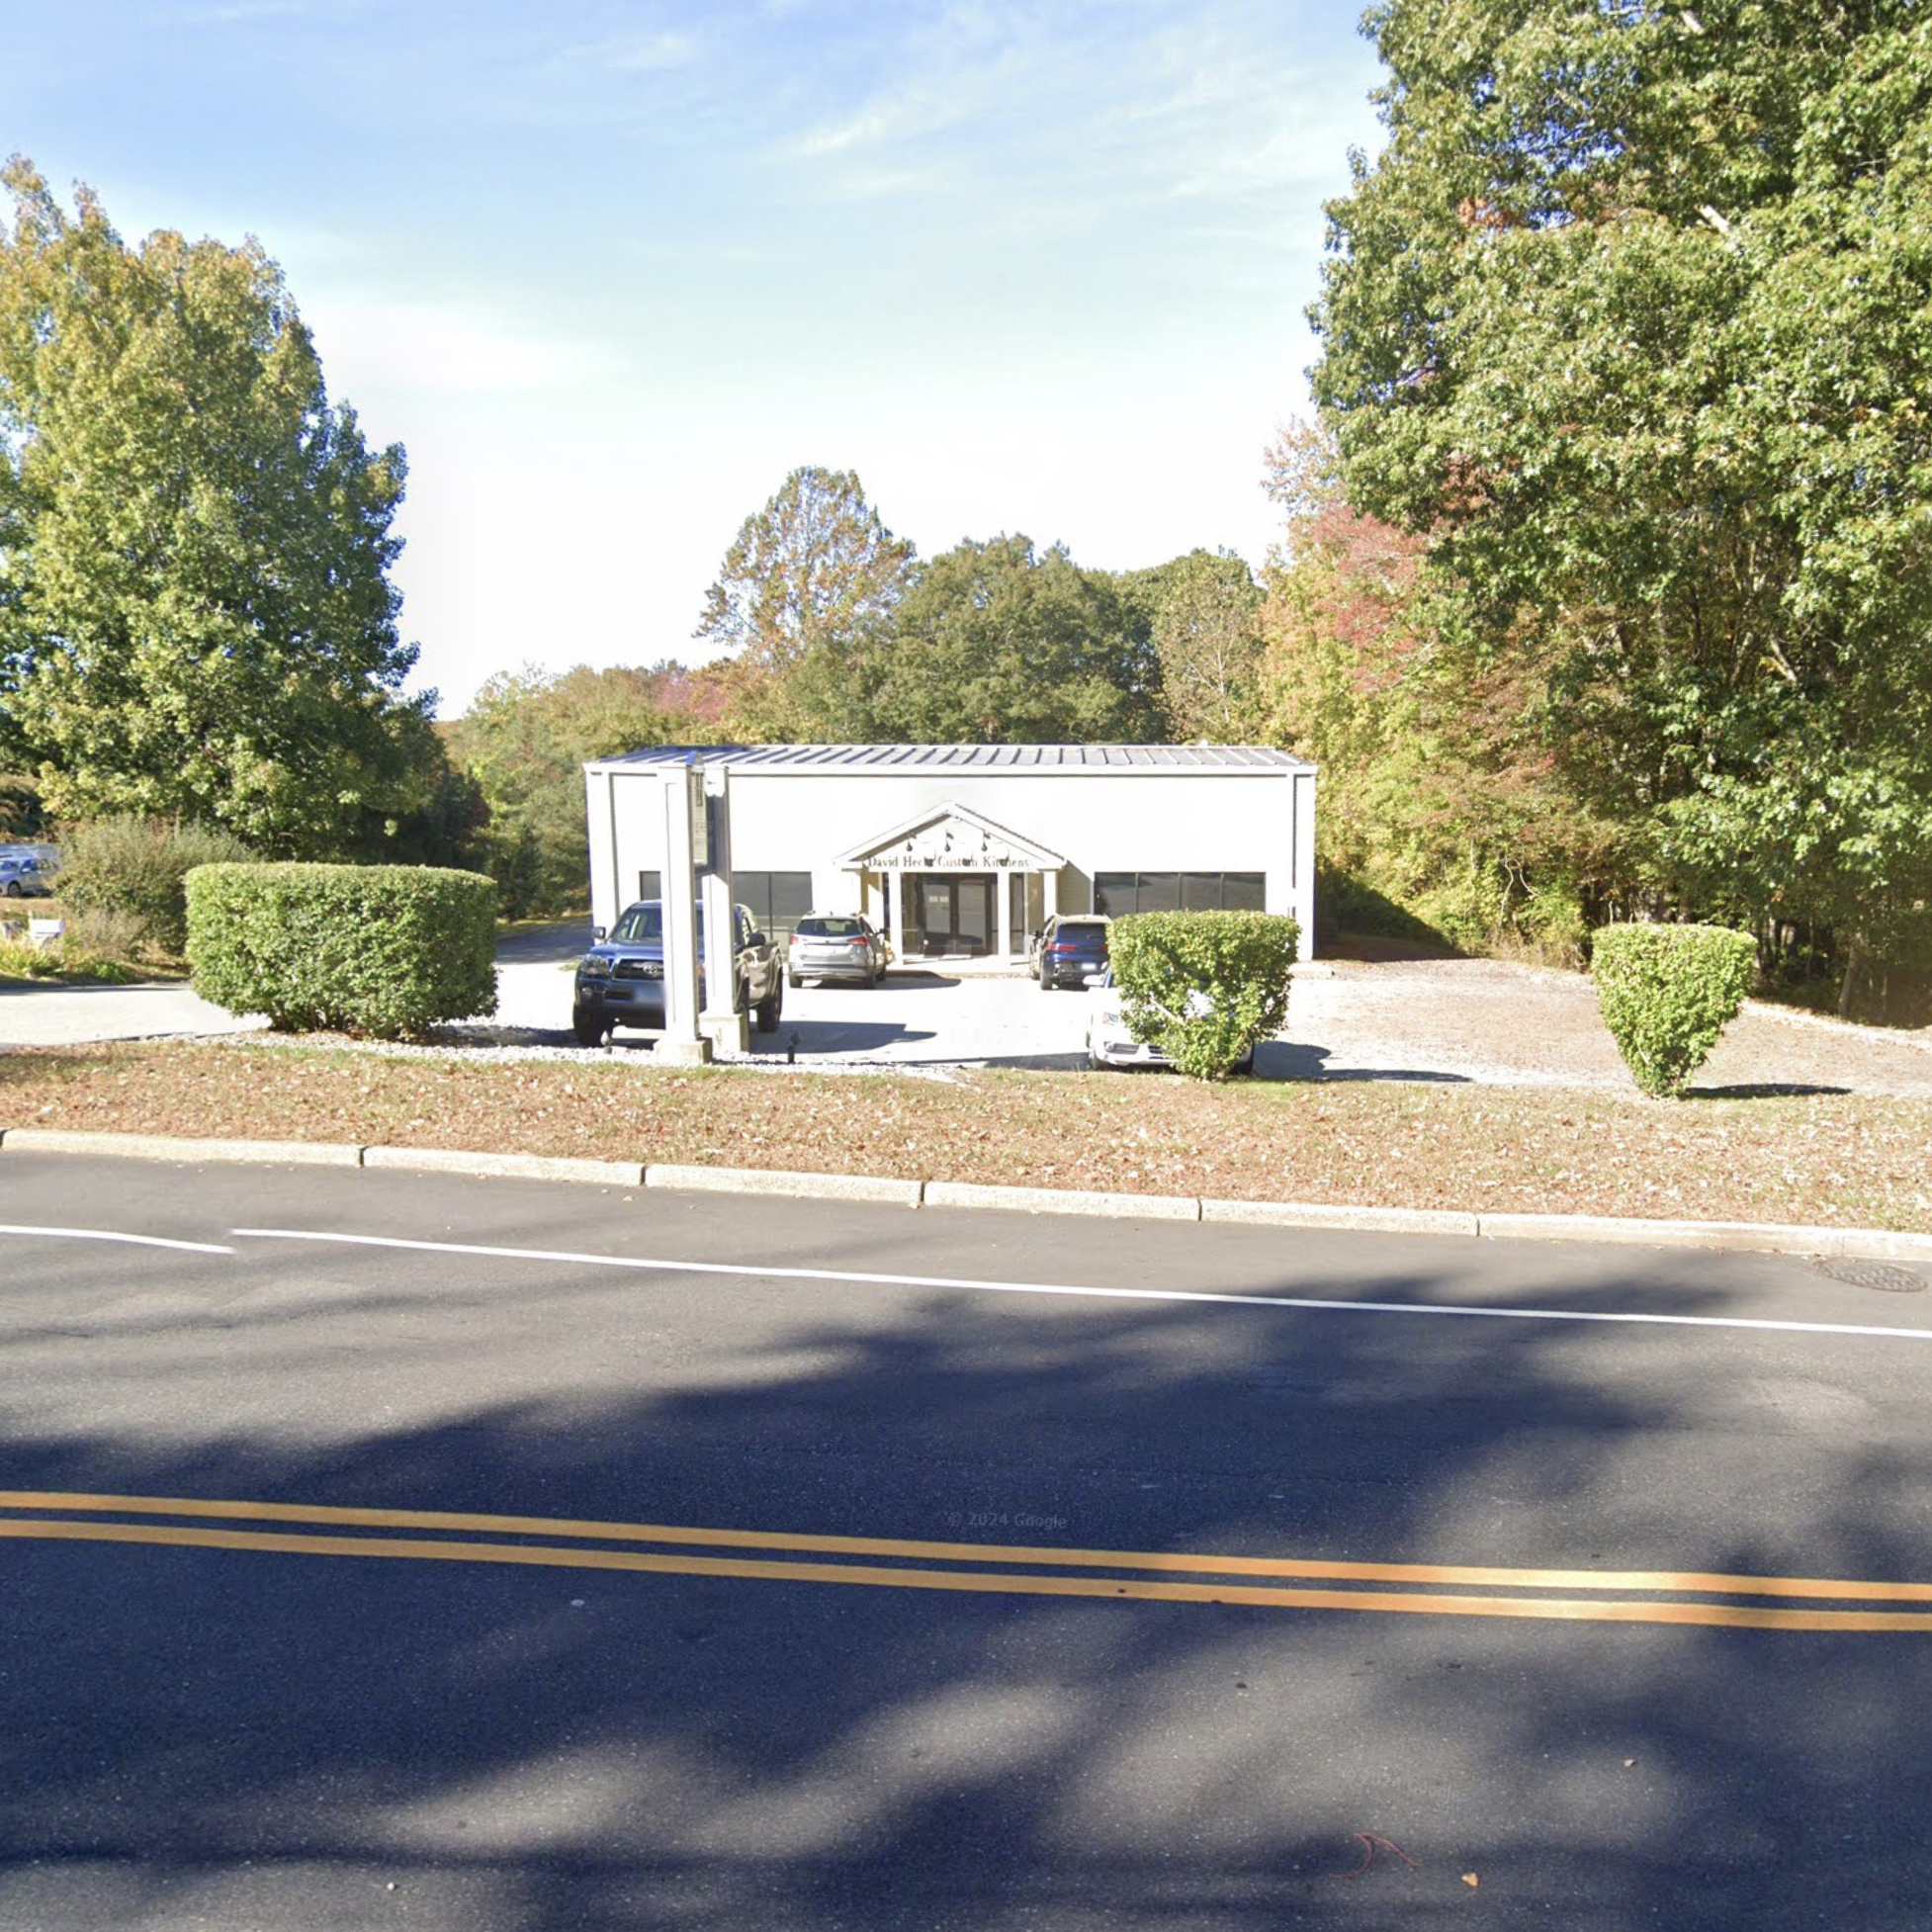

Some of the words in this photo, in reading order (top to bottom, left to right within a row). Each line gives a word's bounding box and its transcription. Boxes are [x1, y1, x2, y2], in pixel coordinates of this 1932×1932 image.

[868, 855, 898, 867] David
[904, 854, 935, 867] Hec
[937, 854, 978, 867] Custm
[983, 853, 1029, 867] Kithens
